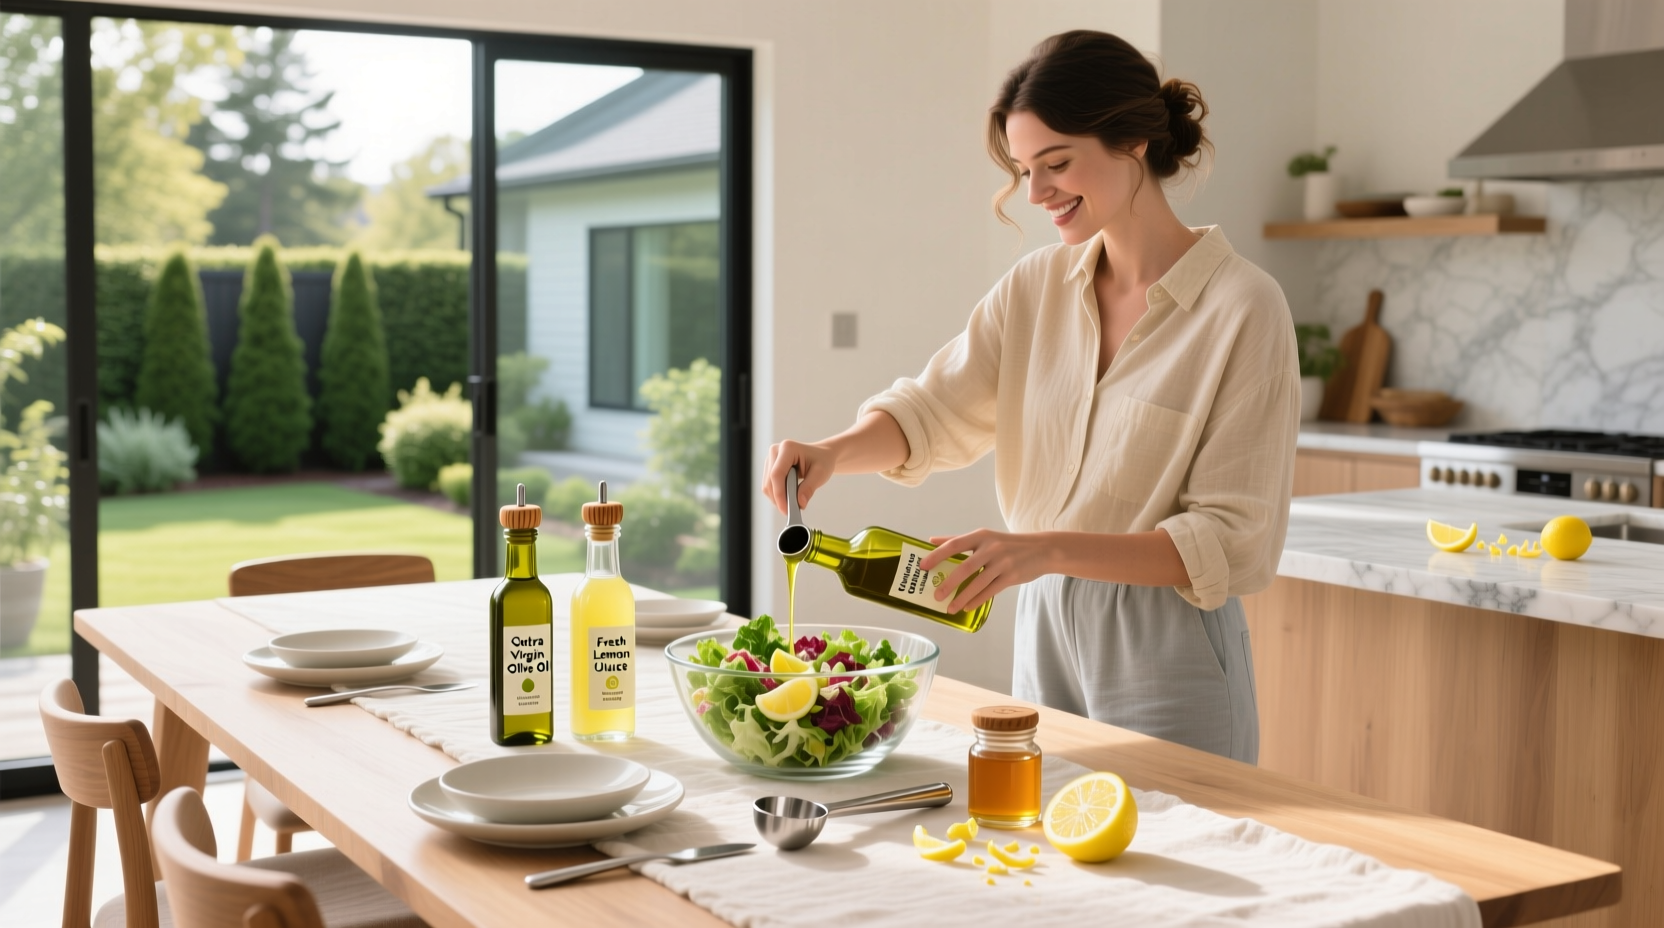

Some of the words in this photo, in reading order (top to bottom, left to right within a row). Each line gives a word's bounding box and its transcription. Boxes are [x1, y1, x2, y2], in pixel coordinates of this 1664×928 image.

[510, 649, 545, 663] Virgin
[593, 650, 630, 660] Lemon
[507, 663, 534, 674] Olive
